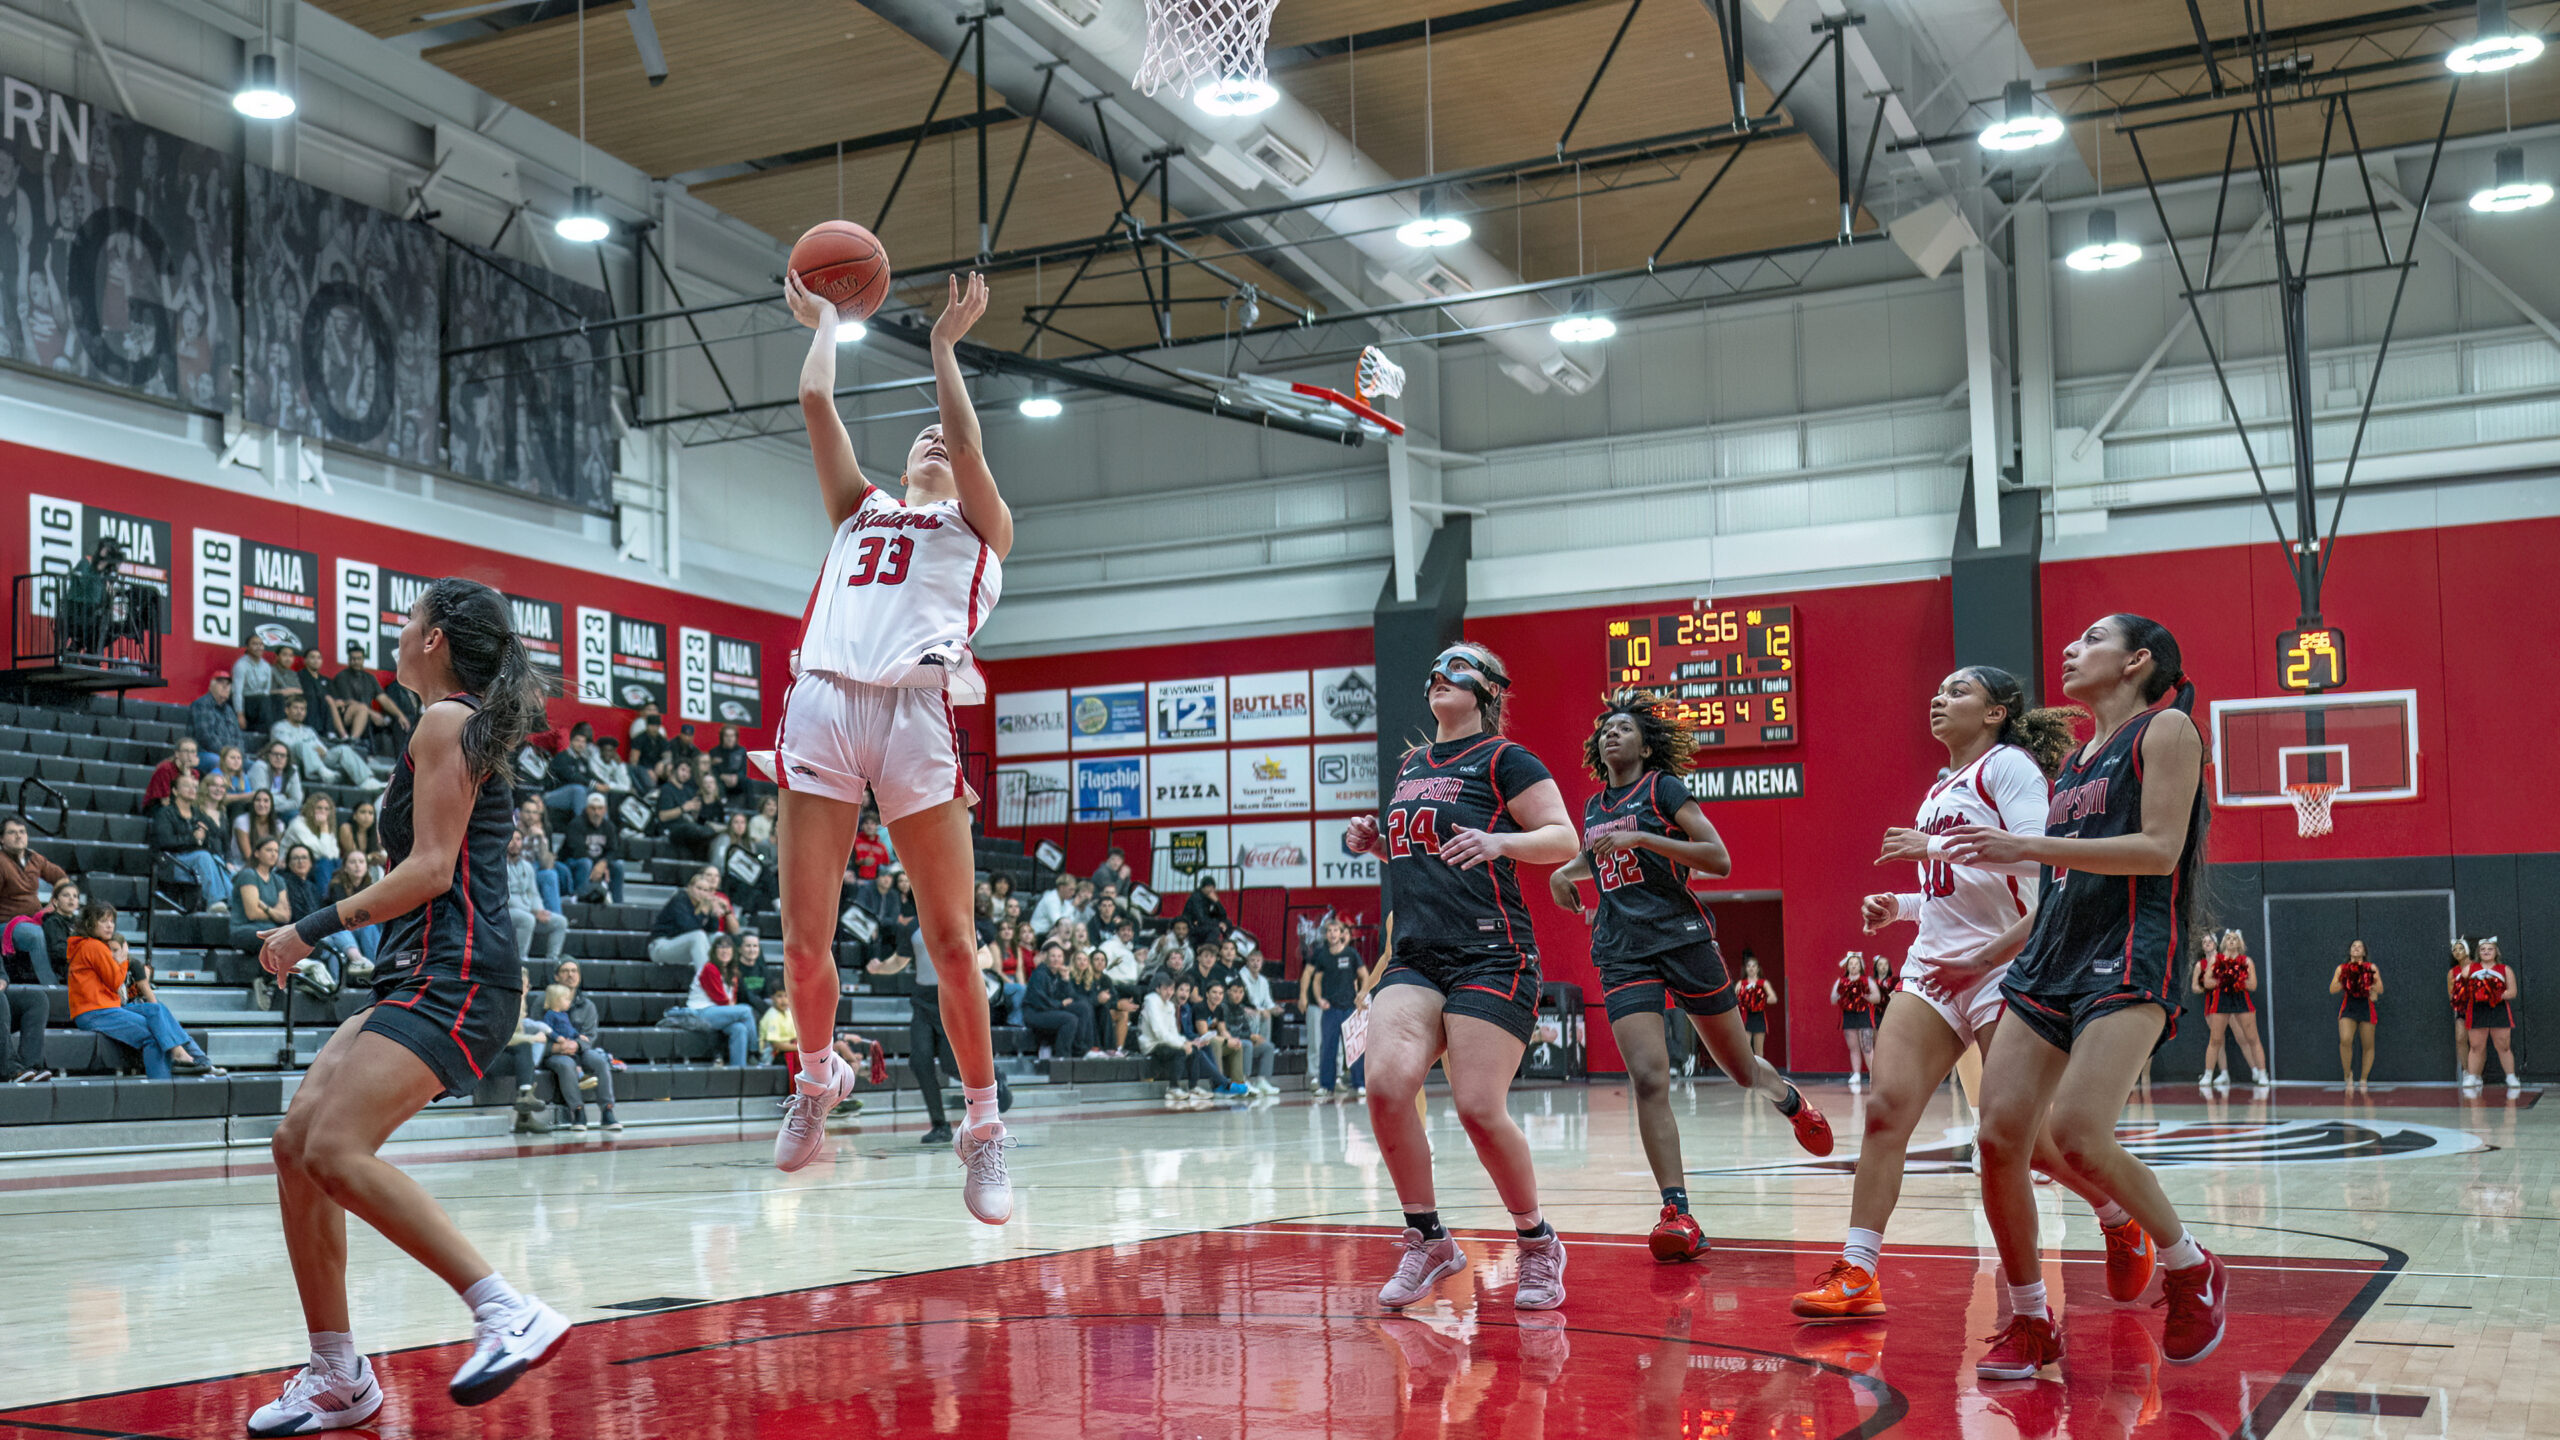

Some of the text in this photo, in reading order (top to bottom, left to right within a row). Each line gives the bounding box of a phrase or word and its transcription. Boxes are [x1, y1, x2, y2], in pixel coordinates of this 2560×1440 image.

[850, 510, 943, 533] Raiders
[254, 548, 304, 593] NAIA
[848, 534, 915, 587] 33
[204, 539, 231, 637] 2018
[346, 569, 370, 660] 2019
[511, 600, 553, 641] NAIA
[1609, 621, 1629, 637] SOU
[1677, 611, 1738, 645] 2:56
[620, 621, 658, 659] NAIA
[1628, 637, 1650, 667] 10
[1766, 625, 1789, 656] 12
[2300, 632, 2330, 649] 2:56
[585, 615, 605, 696] 2023
[718, 641, 754, 676] NAIA
[1683, 660, 1716, 679] period
[1737, 654, 1742, 675] 1
[2287, 647, 2337, 687] 27
[687, 634, 704, 715] 2023
[1762, 678, 1789, 693] fouls
[1233, 693, 1306, 713] BUTLER
[1683, 682, 1717, 699] player
[1014, 711, 1064, 728] ROGUE
[1160, 699, 1207, 731] 12
[1736, 701, 1749, 722] 4
[1772, 697, 1786, 721] 5
[1766, 727, 1788, 740] won
[1080, 768, 1140, 791] Flagship
[1156, 784, 1220, 800] PIZZA
[1732, 767, 1798, 796] ARENA
[1098, 789, 1122, 808] Inn
[1388, 807, 1440, 859] 24
[1323, 861, 1377, 879] TYRE
[1595, 848, 1644, 892] 22
